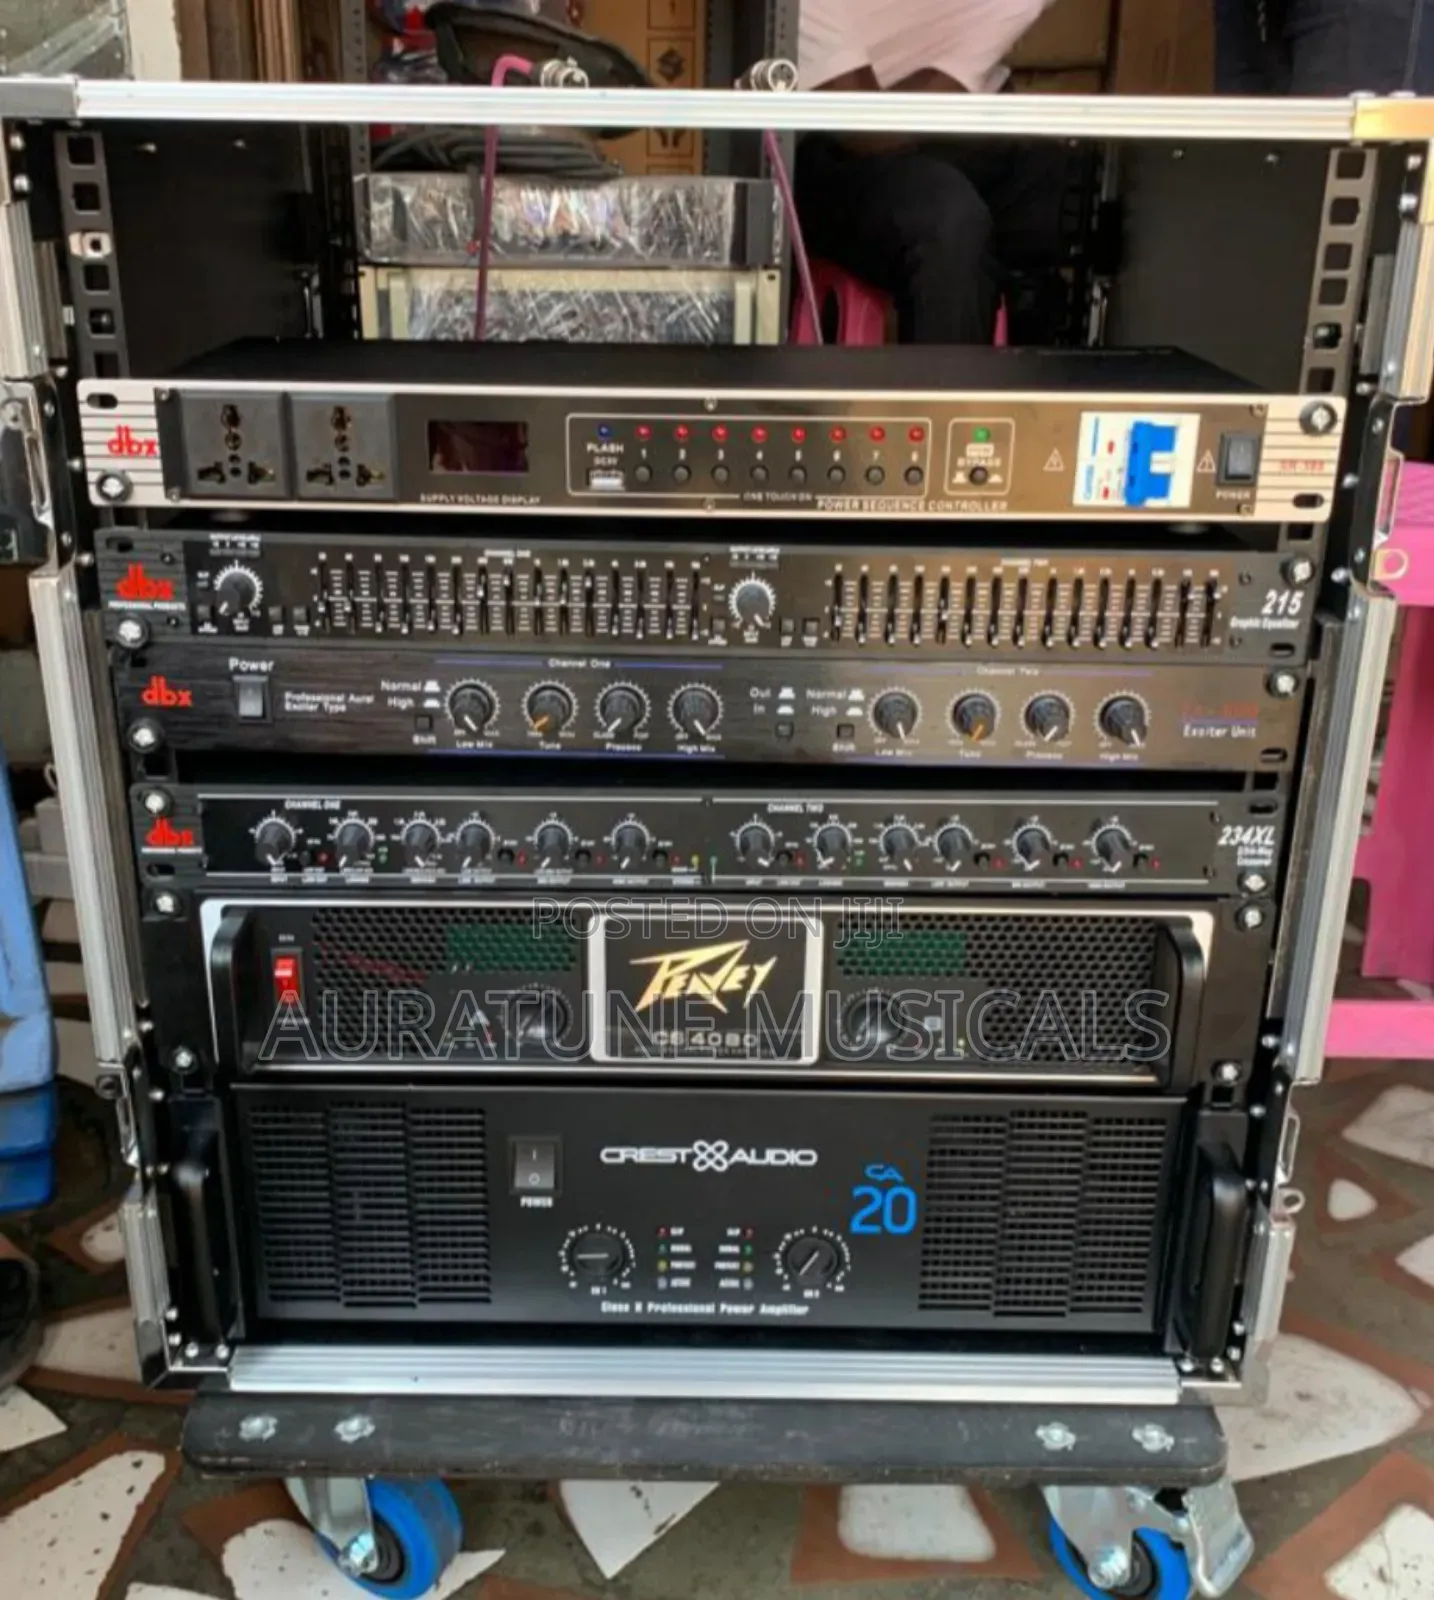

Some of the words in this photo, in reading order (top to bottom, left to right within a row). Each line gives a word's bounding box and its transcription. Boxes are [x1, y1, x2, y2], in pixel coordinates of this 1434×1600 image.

[107, 425, 157, 456] dbx
[1215, 490, 1251, 500] POWER
[817, 500, 859, 511] POWER
[862, 500, 924, 512] SEQUENCE
[928, 501, 1009, 513] CONTROLLER
[115, 562, 173, 600] dbx
[1261, 588, 1305, 615] 215
[228, 657, 275, 672] Power
[140, 675, 192, 708] dbx
[381, 679, 421, 691] Normal
[749, 688, 771, 699] Out
[806, 688, 847, 700] Normal
[387, 697, 415, 710] High
[753, 704, 766, 715] In
[811, 706, 837, 718] High
[1217, 825, 1275, 846] 234XL
[600, 1147, 692, 1165] CREST
[729, 1148, 818, 1167] AUDIO
[865, 1164, 904, 1181] CA
[520, 1195, 553, 1207] POWER
[850, 1185, 918, 1236] 20
[647, 1302, 715, 1314] Professional
[719, 1303, 755, 1315] Power
